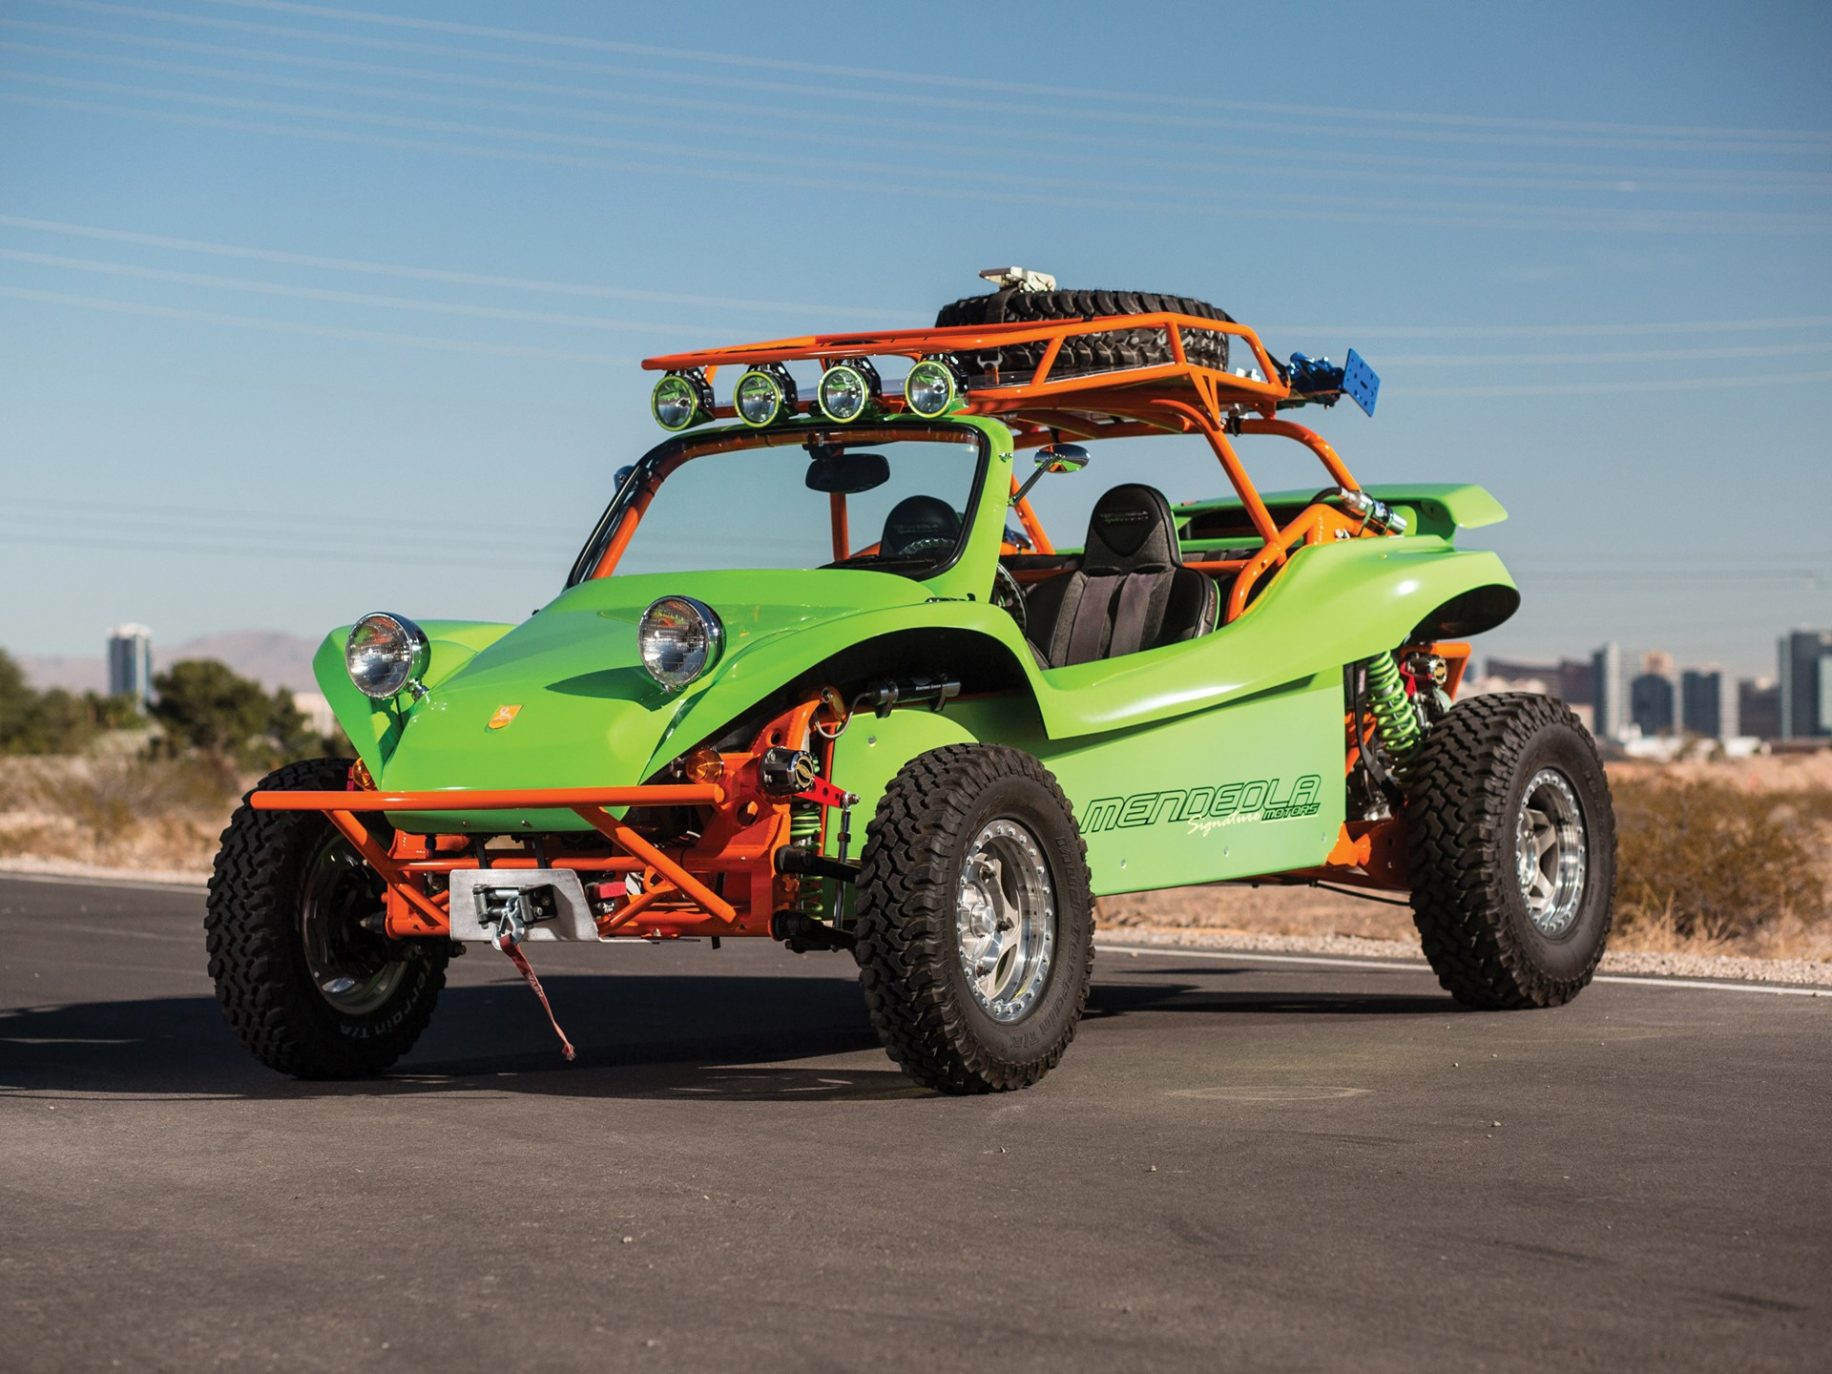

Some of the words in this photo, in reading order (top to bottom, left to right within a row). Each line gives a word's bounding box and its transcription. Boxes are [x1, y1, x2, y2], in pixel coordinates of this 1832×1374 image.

[1079, 774, 1321, 834] MENDEOLA
[1262, 803, 1320, 820] MOTORS
[1187, 810, 1262, 837] Signature
